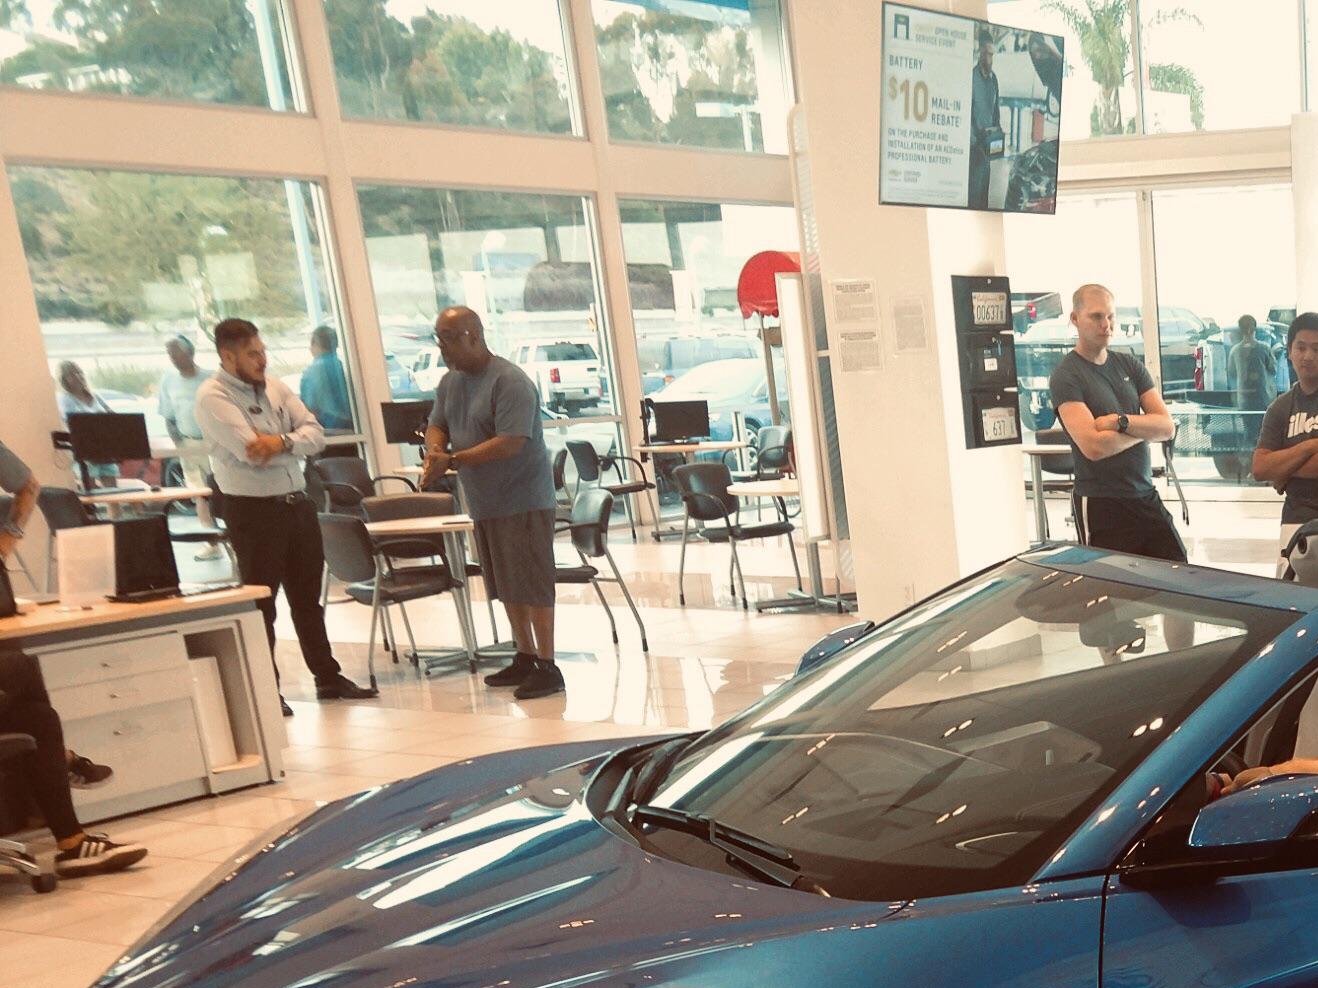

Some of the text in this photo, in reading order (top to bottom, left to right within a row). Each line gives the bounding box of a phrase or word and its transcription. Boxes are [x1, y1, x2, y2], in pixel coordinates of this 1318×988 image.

[889, 55, 923, 70] BATTERY
[888, 76, 929, 122] $10
[931, 97, 961, 111] MAIL-IN
[931, 113, 960, 127] REBATE
[897, 128, 907, 137] THE
[909, 129, 936, 140] PURCHASE
[938, 134, 948, 142] AND
[888, 140, 926, 151] INSTALLATION
[887, 152, 927, 163] PROFESSIONAL
[976, 304, 999, 321] 00637
[993, 420, 1006, 436] 637
